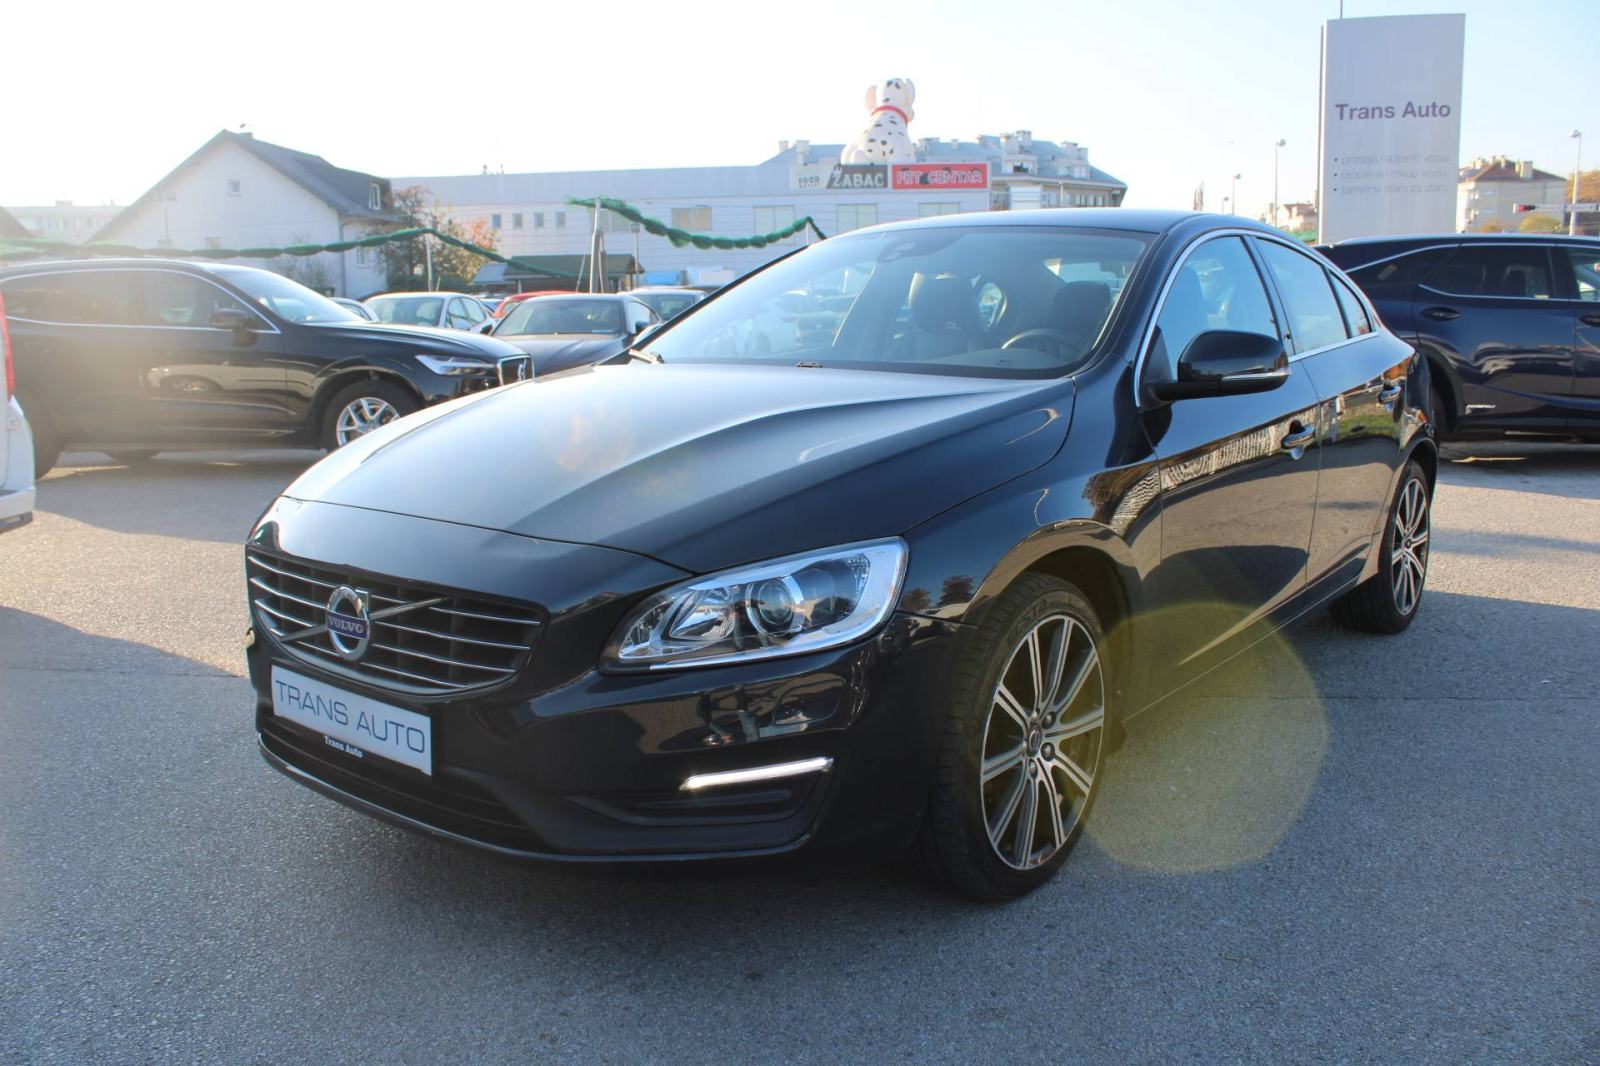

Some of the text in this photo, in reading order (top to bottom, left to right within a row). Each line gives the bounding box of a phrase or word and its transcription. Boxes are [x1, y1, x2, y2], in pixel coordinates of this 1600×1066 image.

[1335, 101, 1451, 120] Trans Auto
[896, 170, 982, 184] PET CENTAR
[327, 616, 364, 634] VOLVO
[275, 680, 425, 754] TRANS AUTO
[323, 735, 363, 758] Trans Auto
